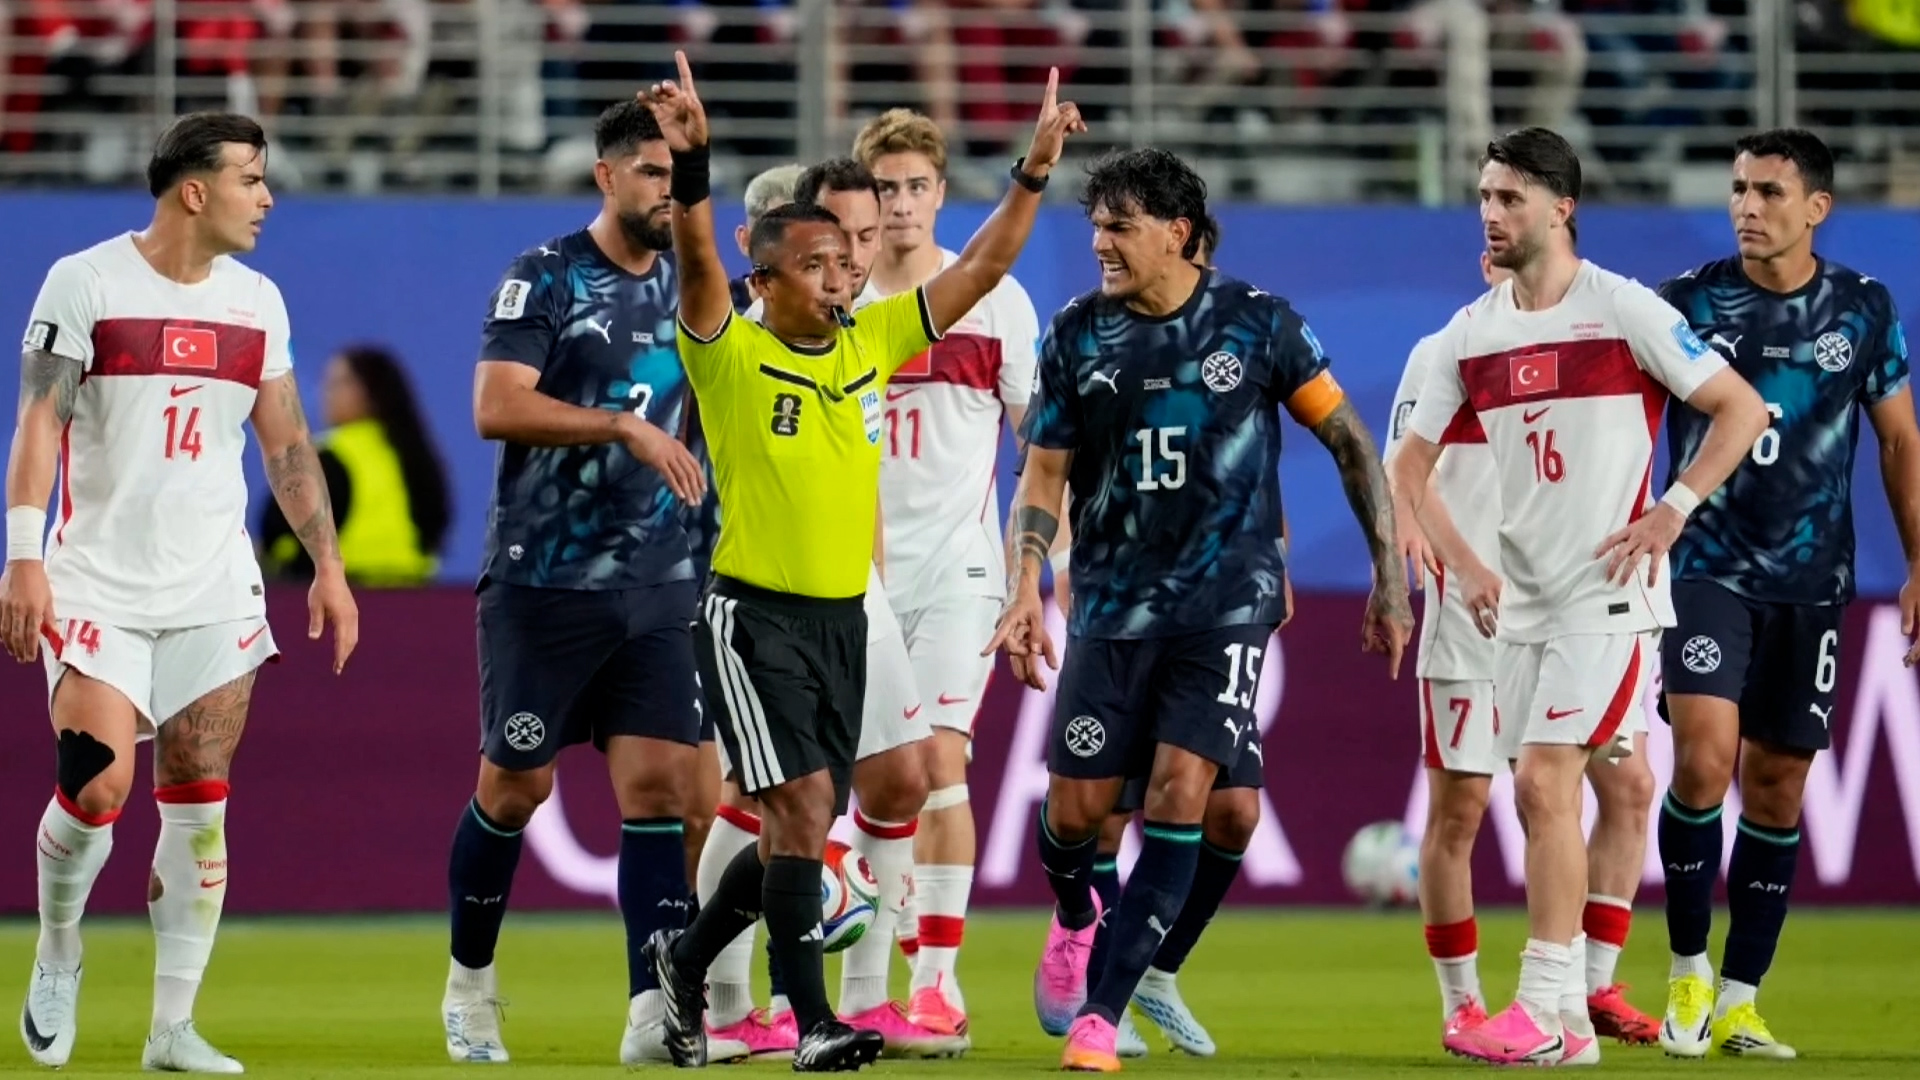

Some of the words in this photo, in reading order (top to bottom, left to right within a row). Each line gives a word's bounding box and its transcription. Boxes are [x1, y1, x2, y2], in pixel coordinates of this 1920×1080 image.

[861, 391, 878, 410] FIFA
[163, 405, 203, 460] 14
[885, 409, 921, 459] 11
[1136, 427, 1187, 491] 15
[1526, 430, 1566, 482] 16
[1752, 402, 1783, 466] 6
[66, 619, 100, 656] 14
[1816, 629, 1837, 693] 6
[1217, 643, 1262, 709] 15
[1449, 698, 1472, 750] 7
